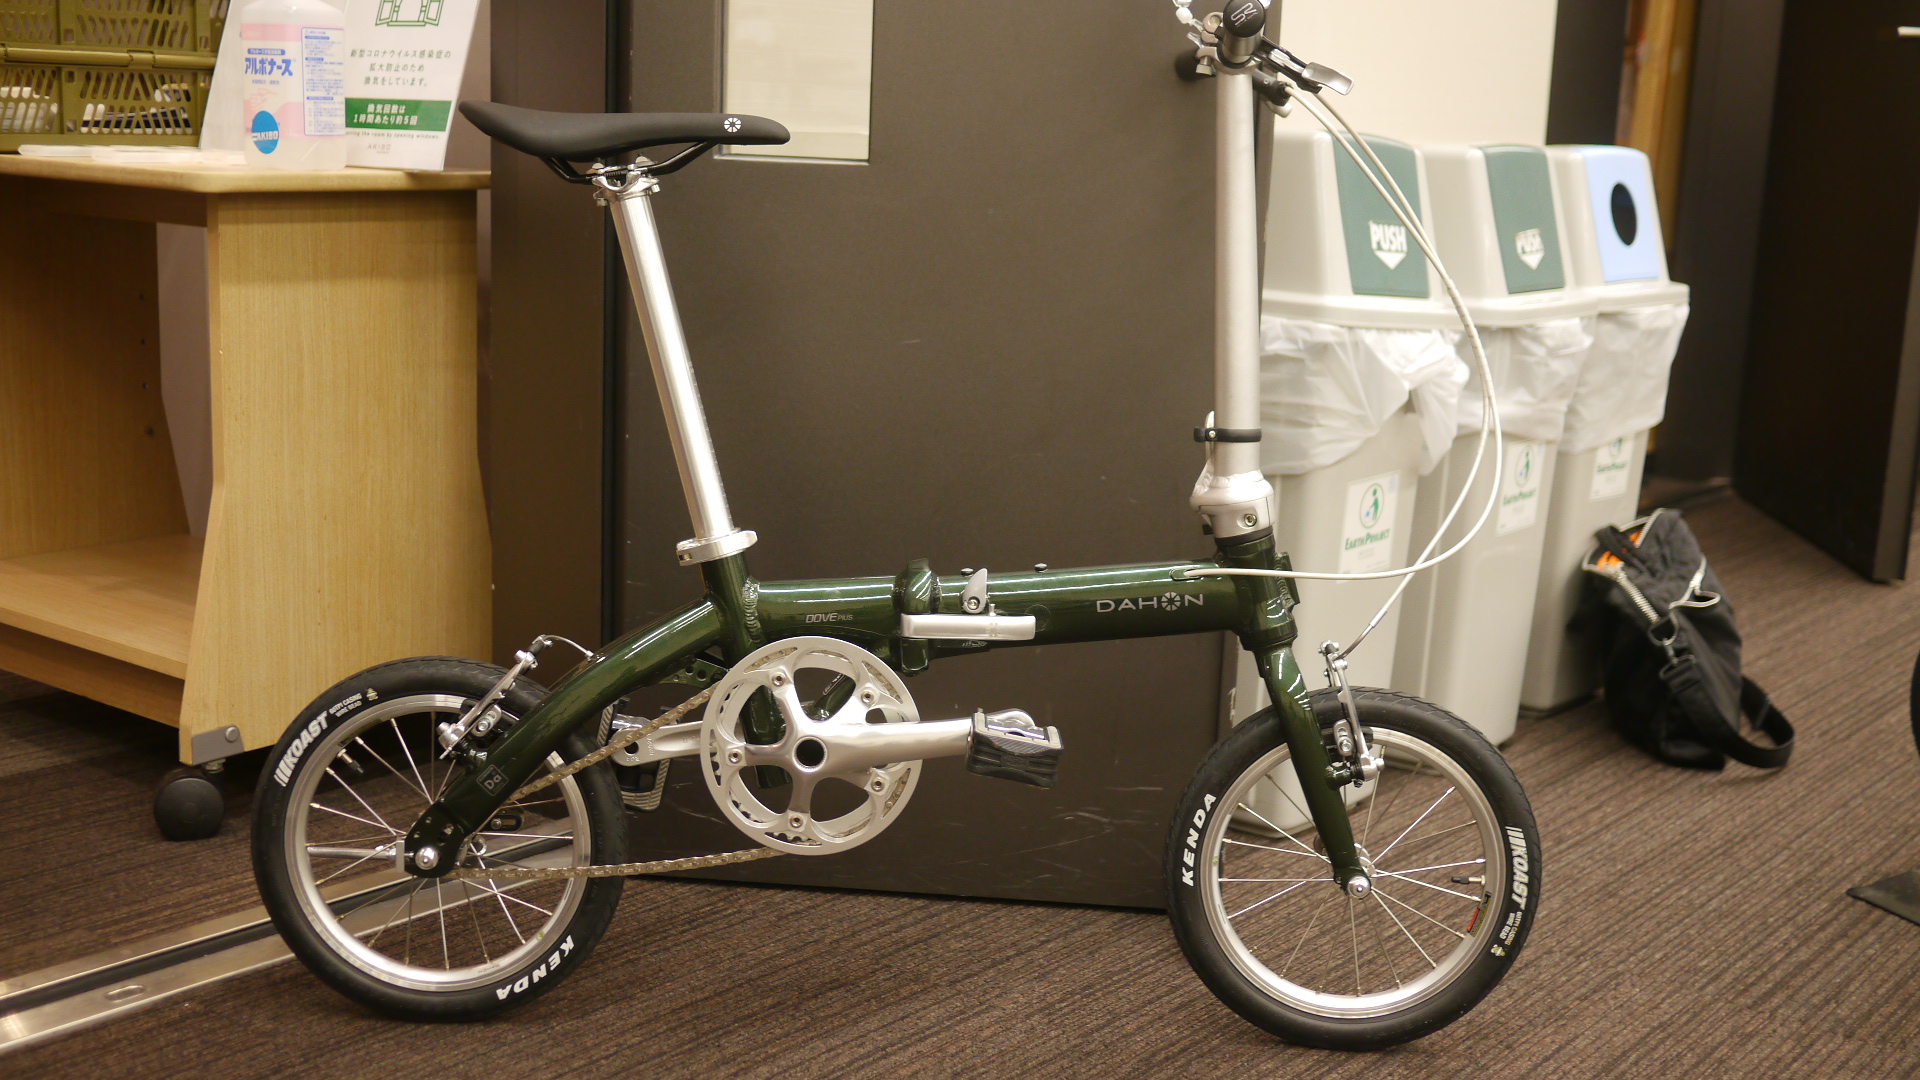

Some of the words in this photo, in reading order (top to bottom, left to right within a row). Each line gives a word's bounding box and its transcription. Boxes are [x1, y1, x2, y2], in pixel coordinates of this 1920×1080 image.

[245, 57, 293, 76] アルボナース
[1370, 222, 1407, 252] PUSH
[1516, 231, 1544, 255] PUSH
[1096, 591, 1204, 613] DAHON
[805, 612, 838, 623] DOVE
[283, 710, 328, 769] KOAST
[1182, 793, 1216, 887] KENDA
[1510, 843, 1529, 911] KOAST
[496, 935, 574, 1000] KENDA
